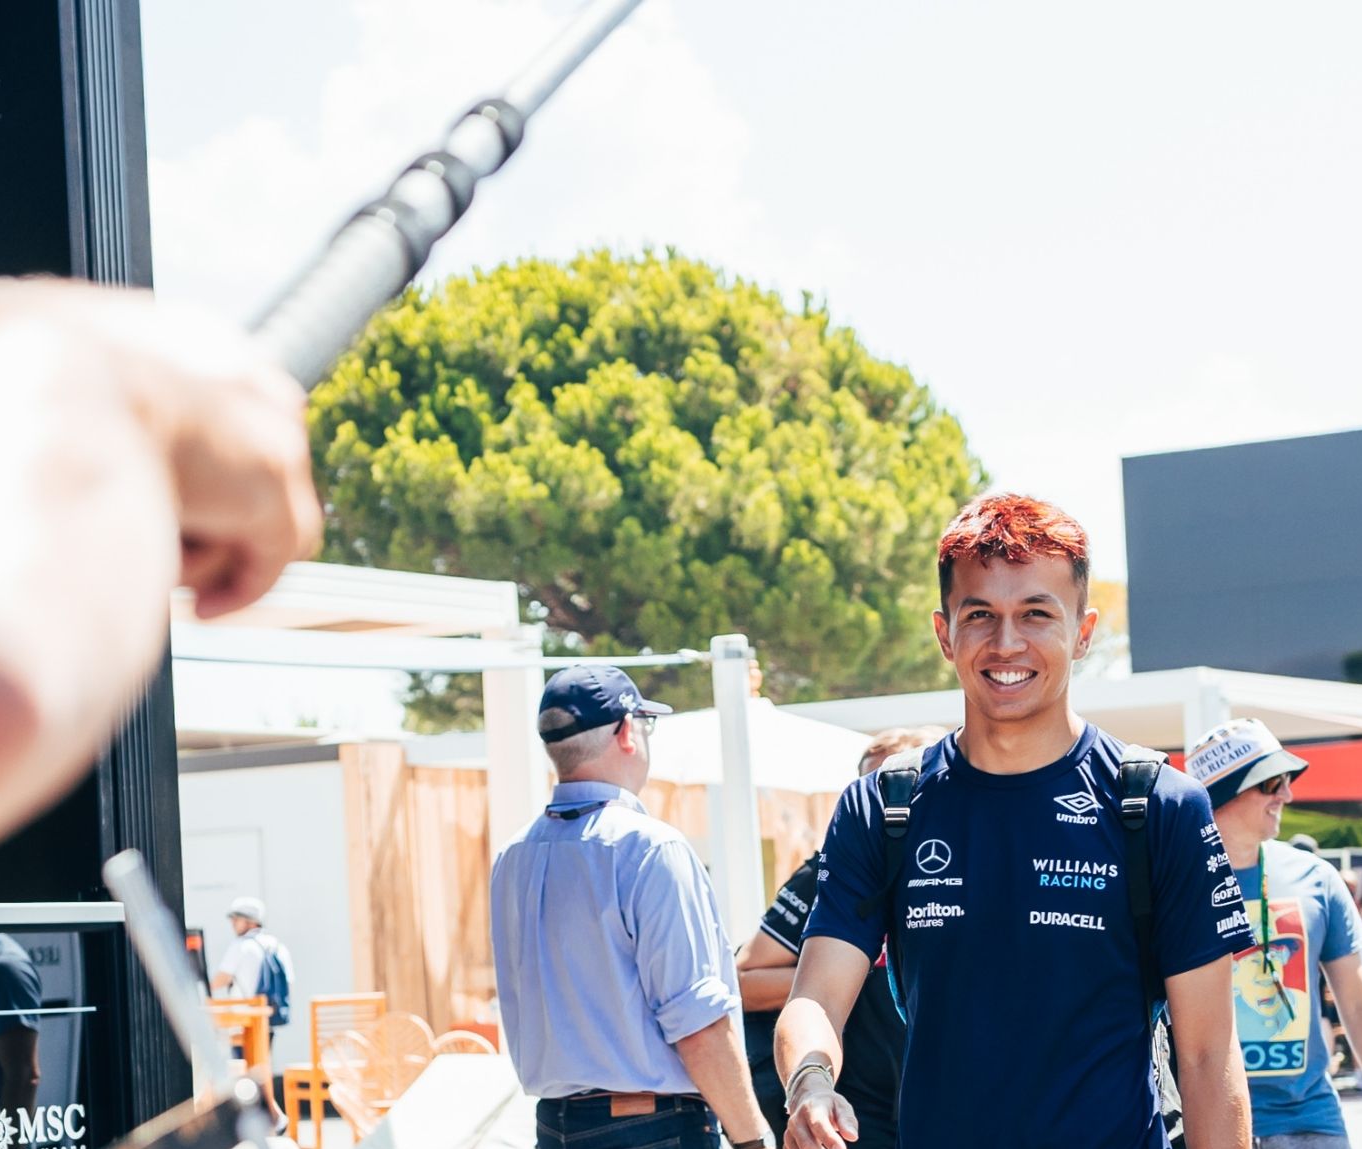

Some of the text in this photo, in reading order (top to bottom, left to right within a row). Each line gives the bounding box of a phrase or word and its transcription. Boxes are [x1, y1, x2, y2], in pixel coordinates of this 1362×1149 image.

[1192, 740, 1233, 770] CIRCUIT
[1208, 743, 1252, 777] RICARD
[1056, 813, 1098, 825] umbro
[1033, 859, 1118, 878] WILLIAMS
[1040, 874, 1107, 890] RACING
[906, 918, 944, 929] Ventures
[1029, 911, 1106, 931] DURACELL
[1241, 1042, 1304, 1070] OSS
[17, 1103, 86, 1144] MSC
